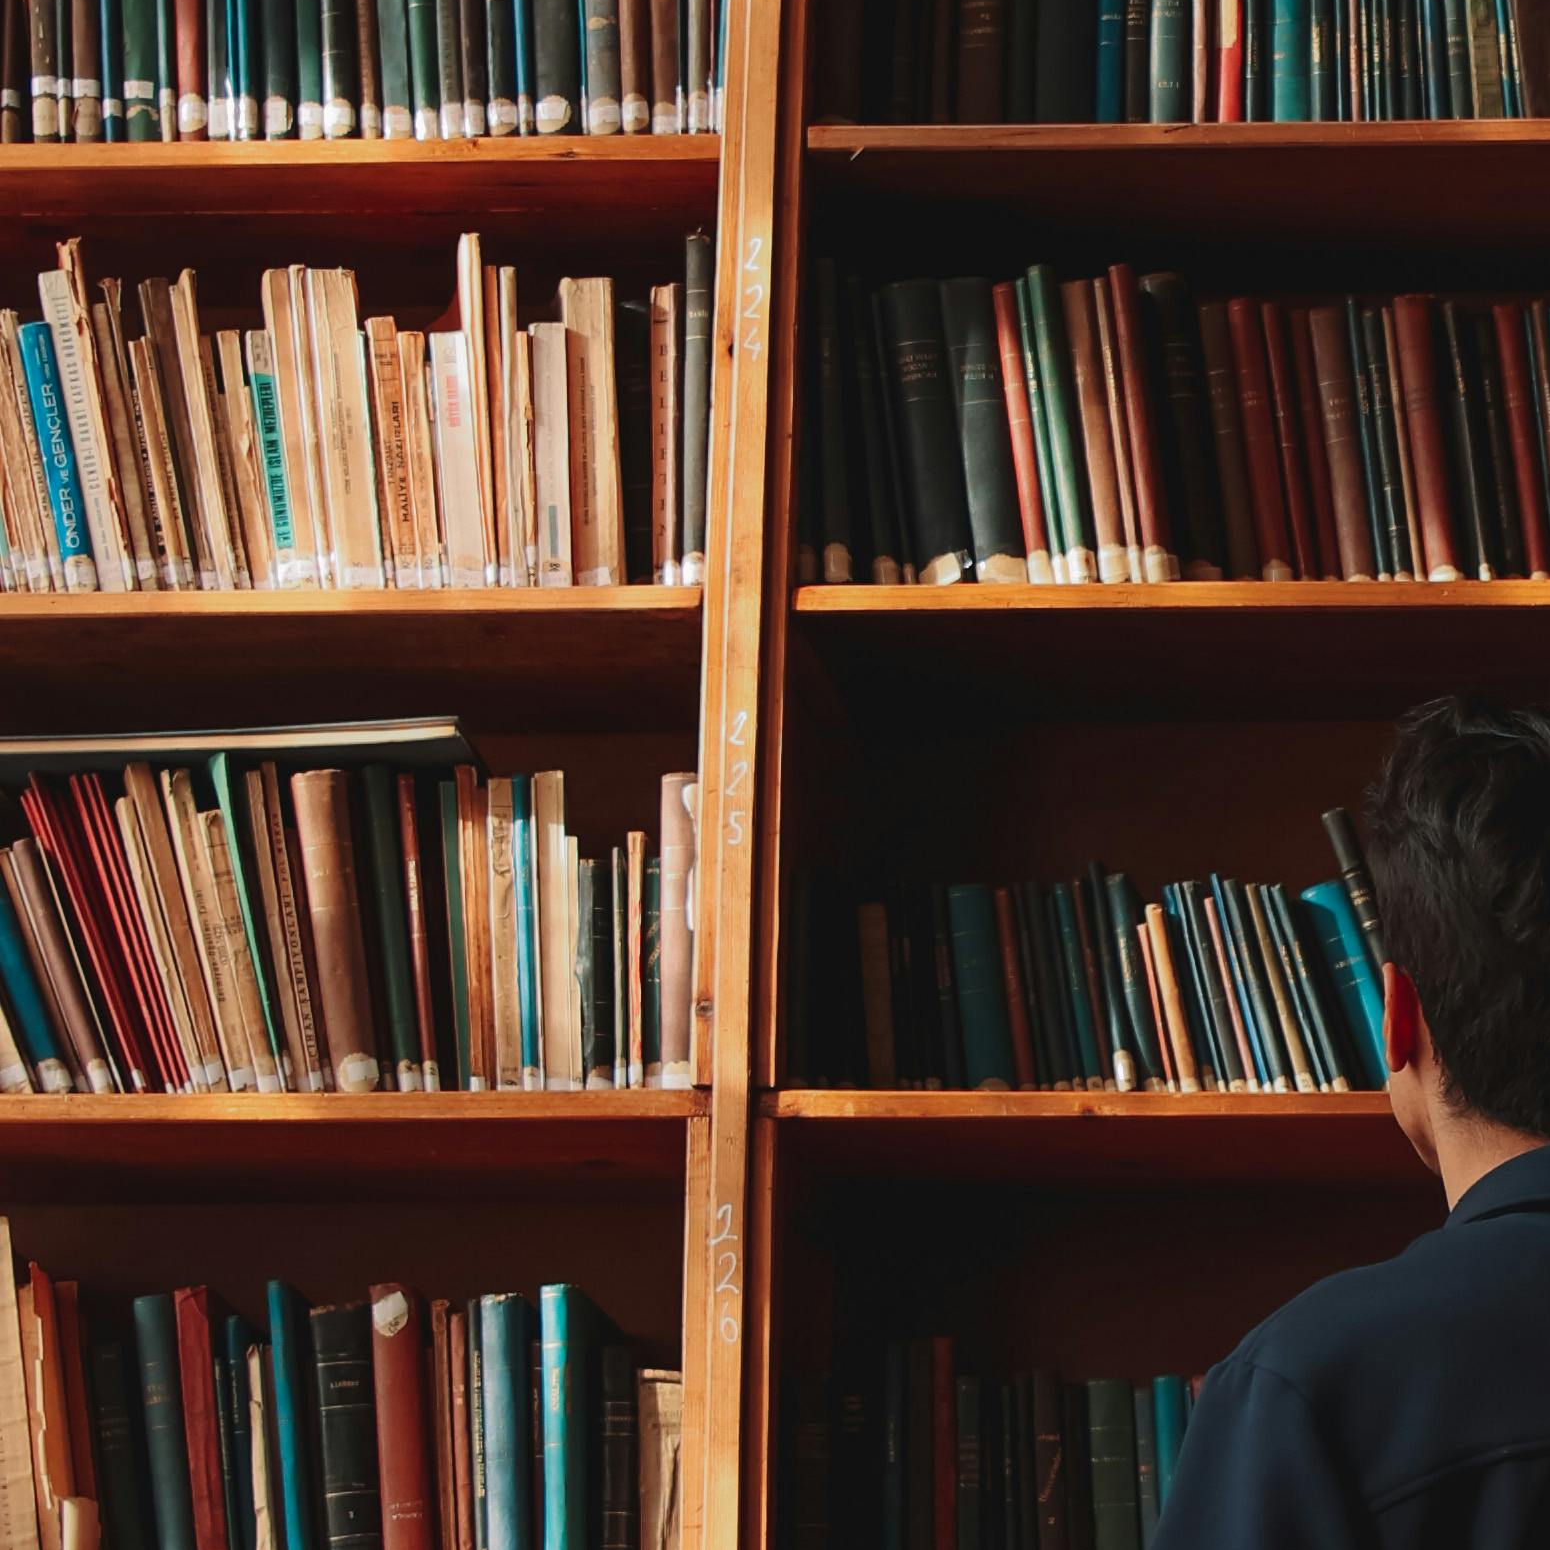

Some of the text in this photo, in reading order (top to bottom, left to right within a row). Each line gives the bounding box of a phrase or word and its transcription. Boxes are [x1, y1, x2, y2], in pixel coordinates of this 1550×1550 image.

[743, 237, 765, 363] 224
[41, 383, 69, 469] GENÇLER
[264, 439, 283, 470] İSLAM
[59, 488, 81, 549] ÖNDER
[725, 711, 749, 846] 225
[708, 1203, 739, 1344] 226
